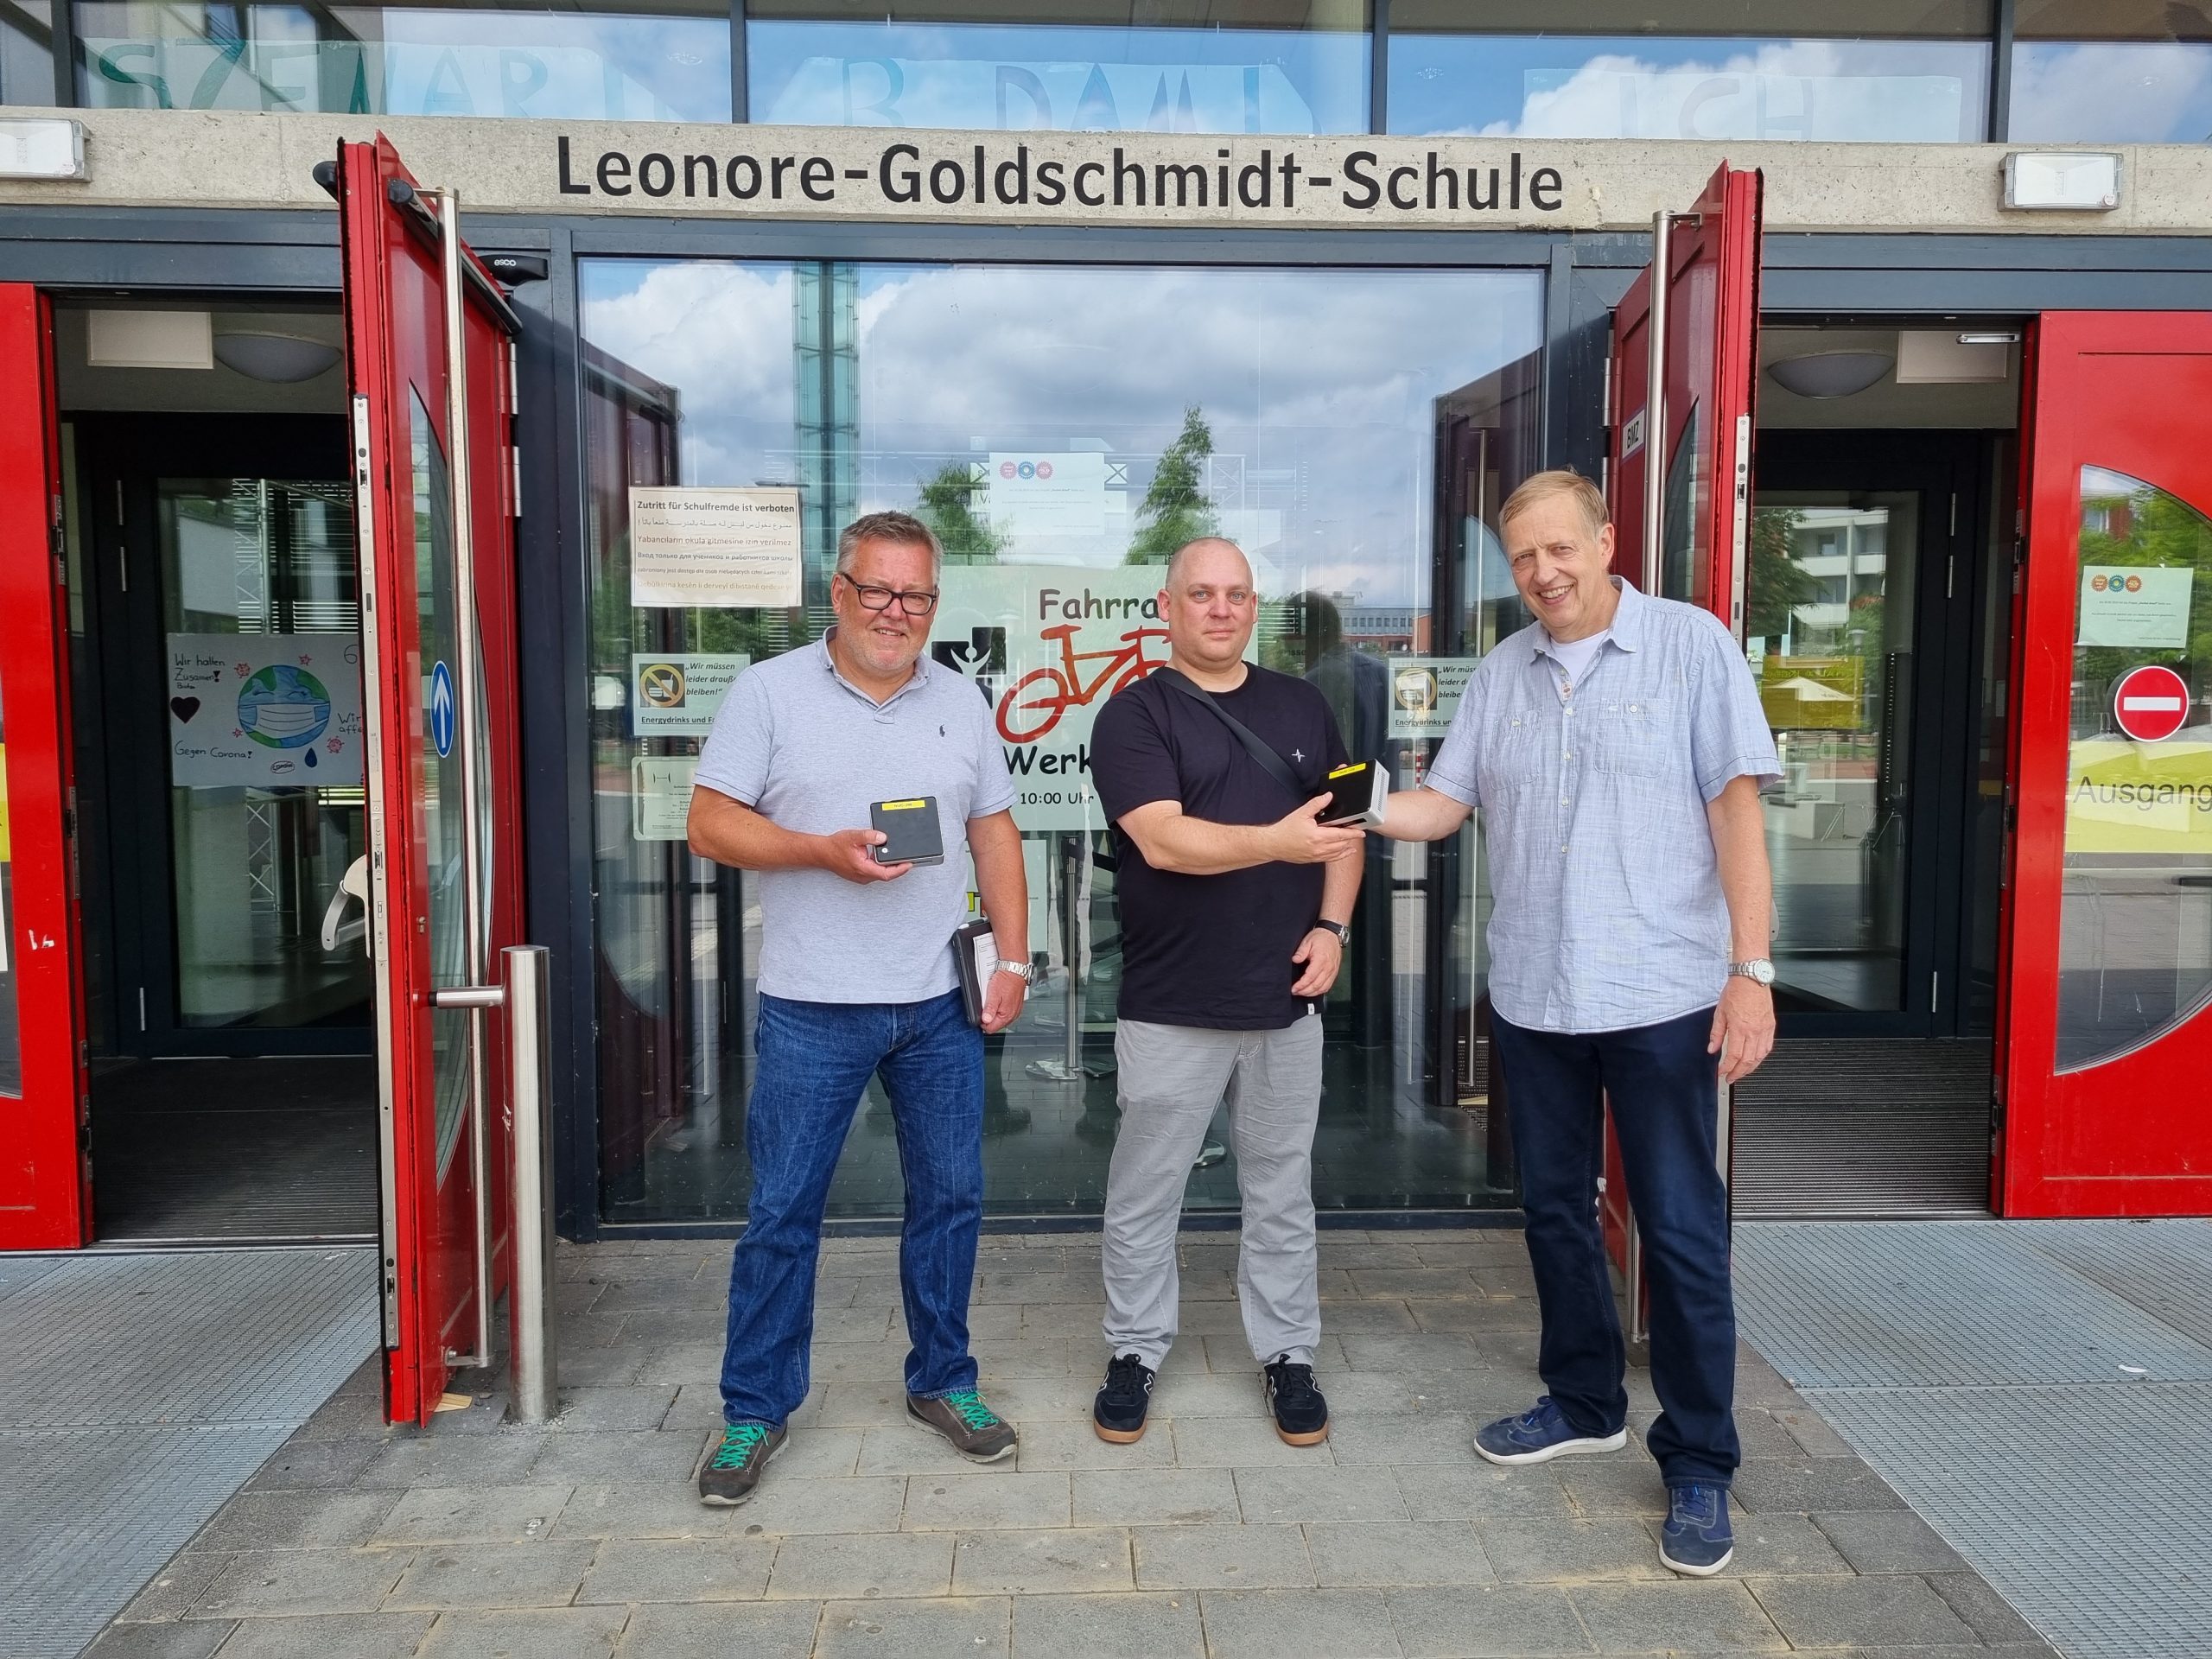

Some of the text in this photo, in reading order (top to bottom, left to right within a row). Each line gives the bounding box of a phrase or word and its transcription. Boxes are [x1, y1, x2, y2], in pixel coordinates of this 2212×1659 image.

[558, 136, 1563, 211] Leonore-Goldschmidt-Schule
[637, 501, 795, 512] Zutritt für Schulfremde ist verboten
[760, 537, 791, 546] verilmez
[1039, 588, 1160, 620] Fahrra
[175, 652, 226, 666] Wir halten
[338, 712, 361, 725] Wir
[641, 716, 690, 725] Energydrinks
[1395, 718, 1441, 727] Energydrinks
[175, 741, 252, 760] Gegen Corona!
[1002, 743, 1090, 775] Werk
[1020, 792, 1094, 804] 10:00 Uhr
[2074, 776, 2212, 811] Ausgang
